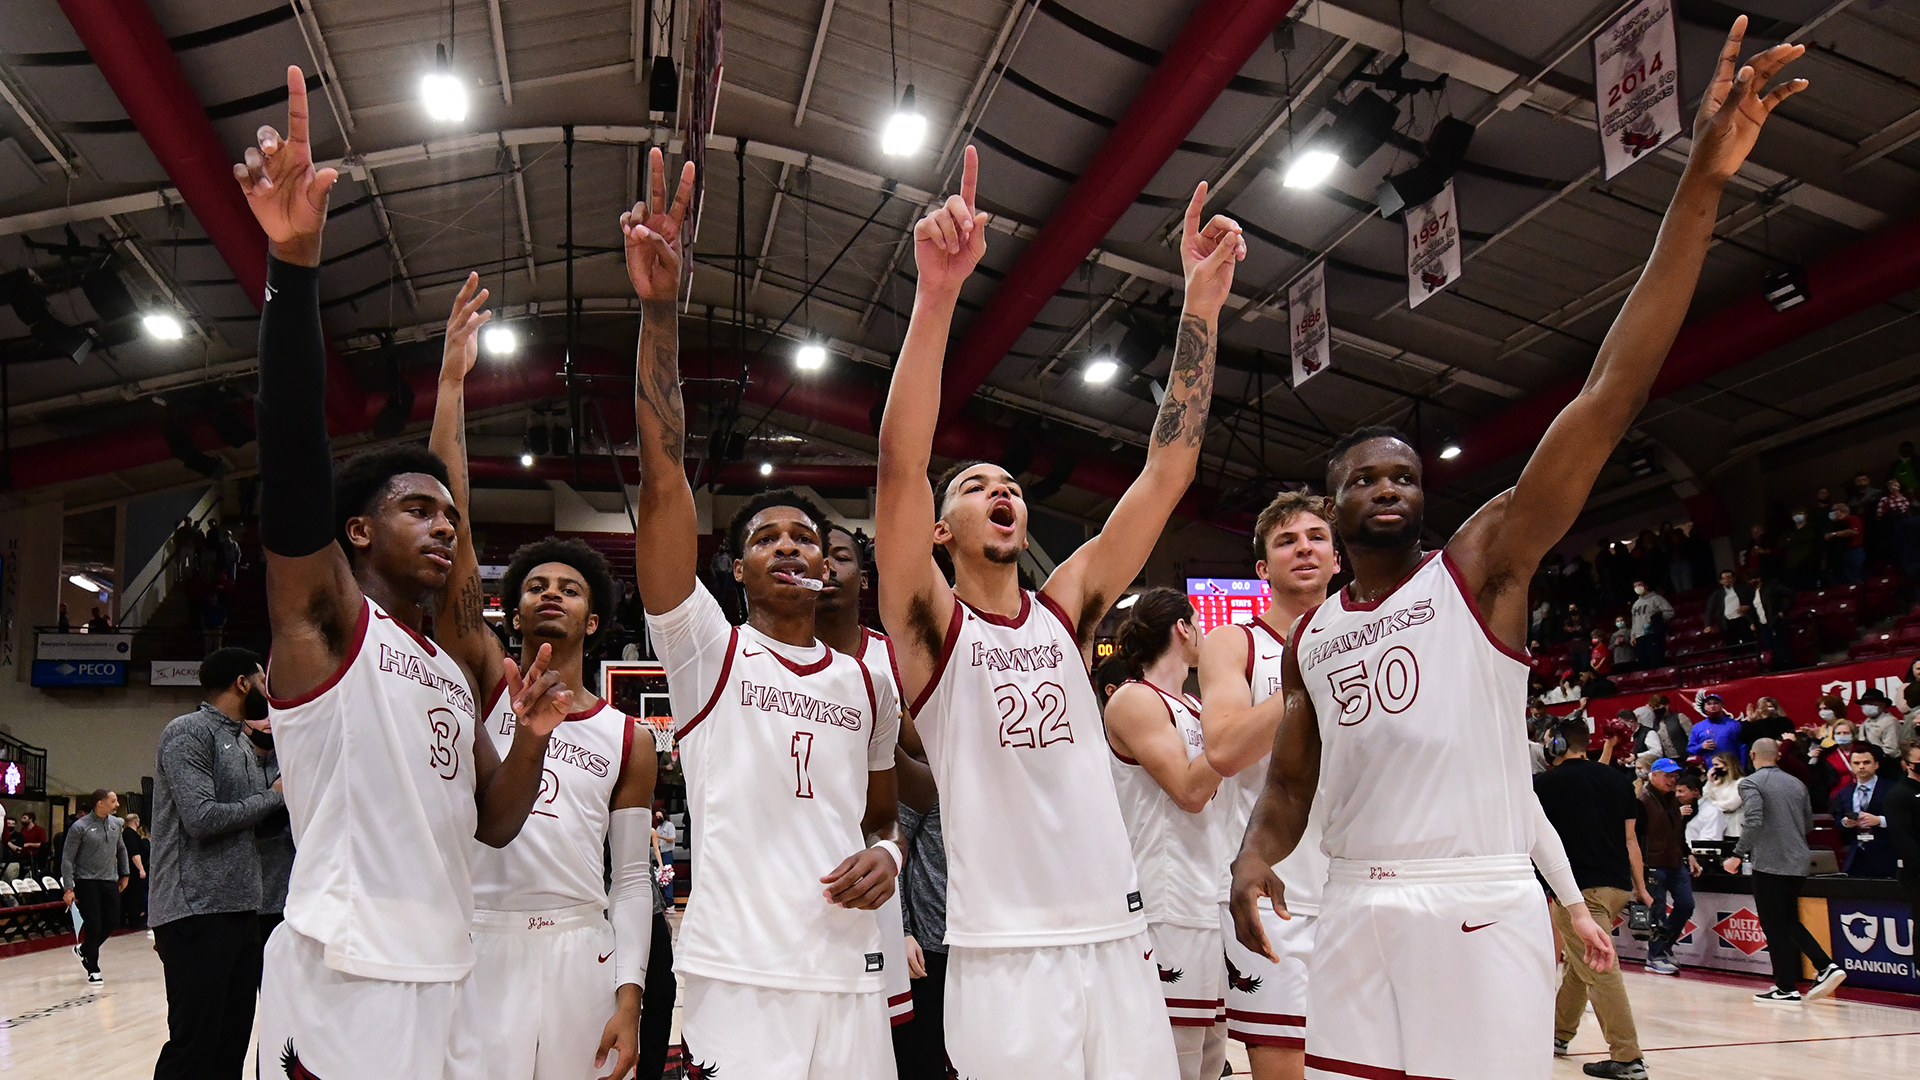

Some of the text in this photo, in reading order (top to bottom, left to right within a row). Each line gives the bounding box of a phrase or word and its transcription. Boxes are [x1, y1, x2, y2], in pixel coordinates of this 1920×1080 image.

[1608, 51, 1664, 108] 2014
[1412, 210, 1449, 250] 1997
[1296, 308, 1321, 338] 1986
[1231, 581, 1251, 590] 00.0
[1097, 643, 1113, 657] 00
[1308, 598, 1435, 671] HAWKS
[78, 663, 116, 676] PECO
[1327, 645, 1420, 727] 50
[741, 680, 862, 731] HAWKS
[994, 681, 1074, 749] 22
[427, 707, 461, 781] 3
[500, 712, 610, 778] HWKS
[791, 731, 814, 799] 1
[537, 916, 555, 930] Joe's
[1729, 918, 1759, 930] DIETZ
[1844, 958, 1909, 976] BANKING
